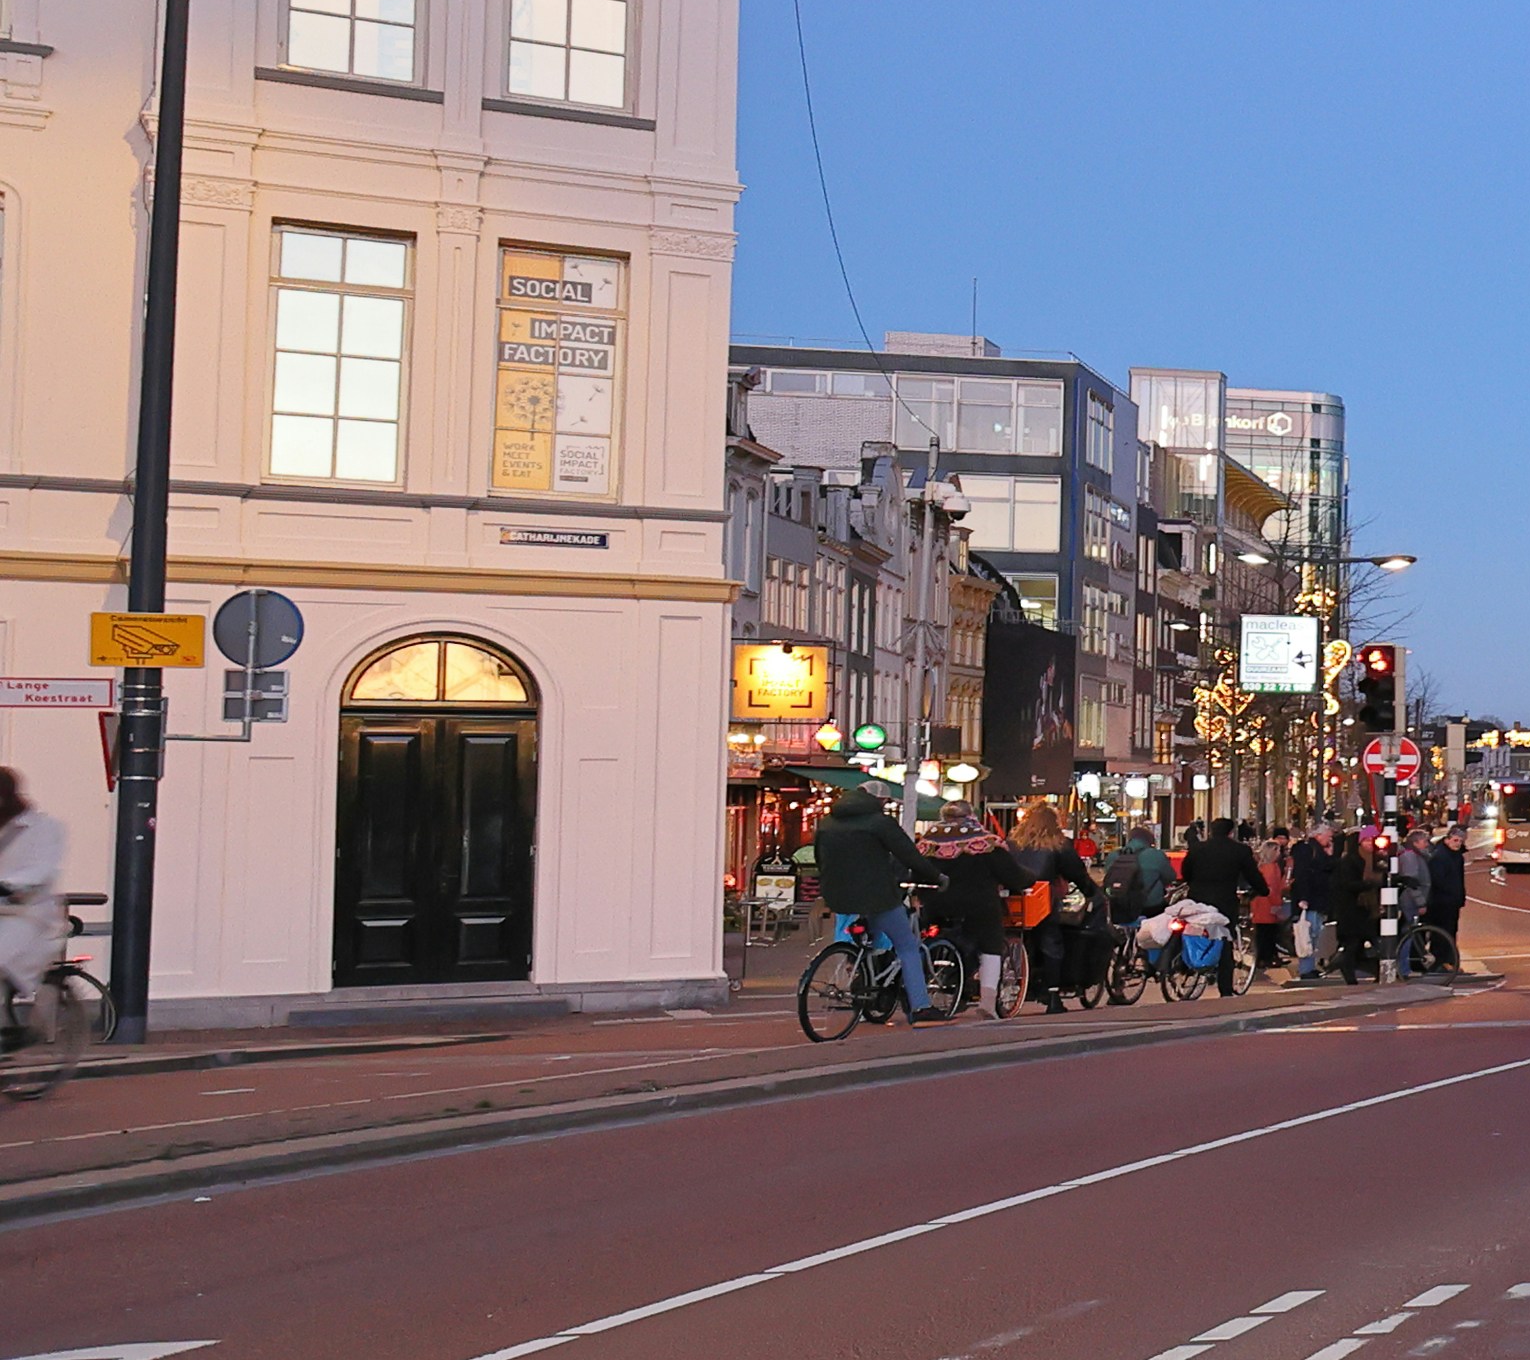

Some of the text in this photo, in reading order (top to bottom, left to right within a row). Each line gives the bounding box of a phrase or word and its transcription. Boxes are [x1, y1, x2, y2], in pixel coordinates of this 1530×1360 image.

[511, 278, 589, 301] SOCIAL
[534, 321, 613, 343] IMPACT
[503, 344, 604, 367] FACTORY
[559, 449, 600, 460] SOCIAL
[502, 460, 543, 470] EVENTS
[559, 460, 600, 470] IMPACT
[509, 531, 601, 545] CATHARIJNEKADE
[7, 682, 49, 691] Lange
[24, 694, 93, 703] Koestraat
